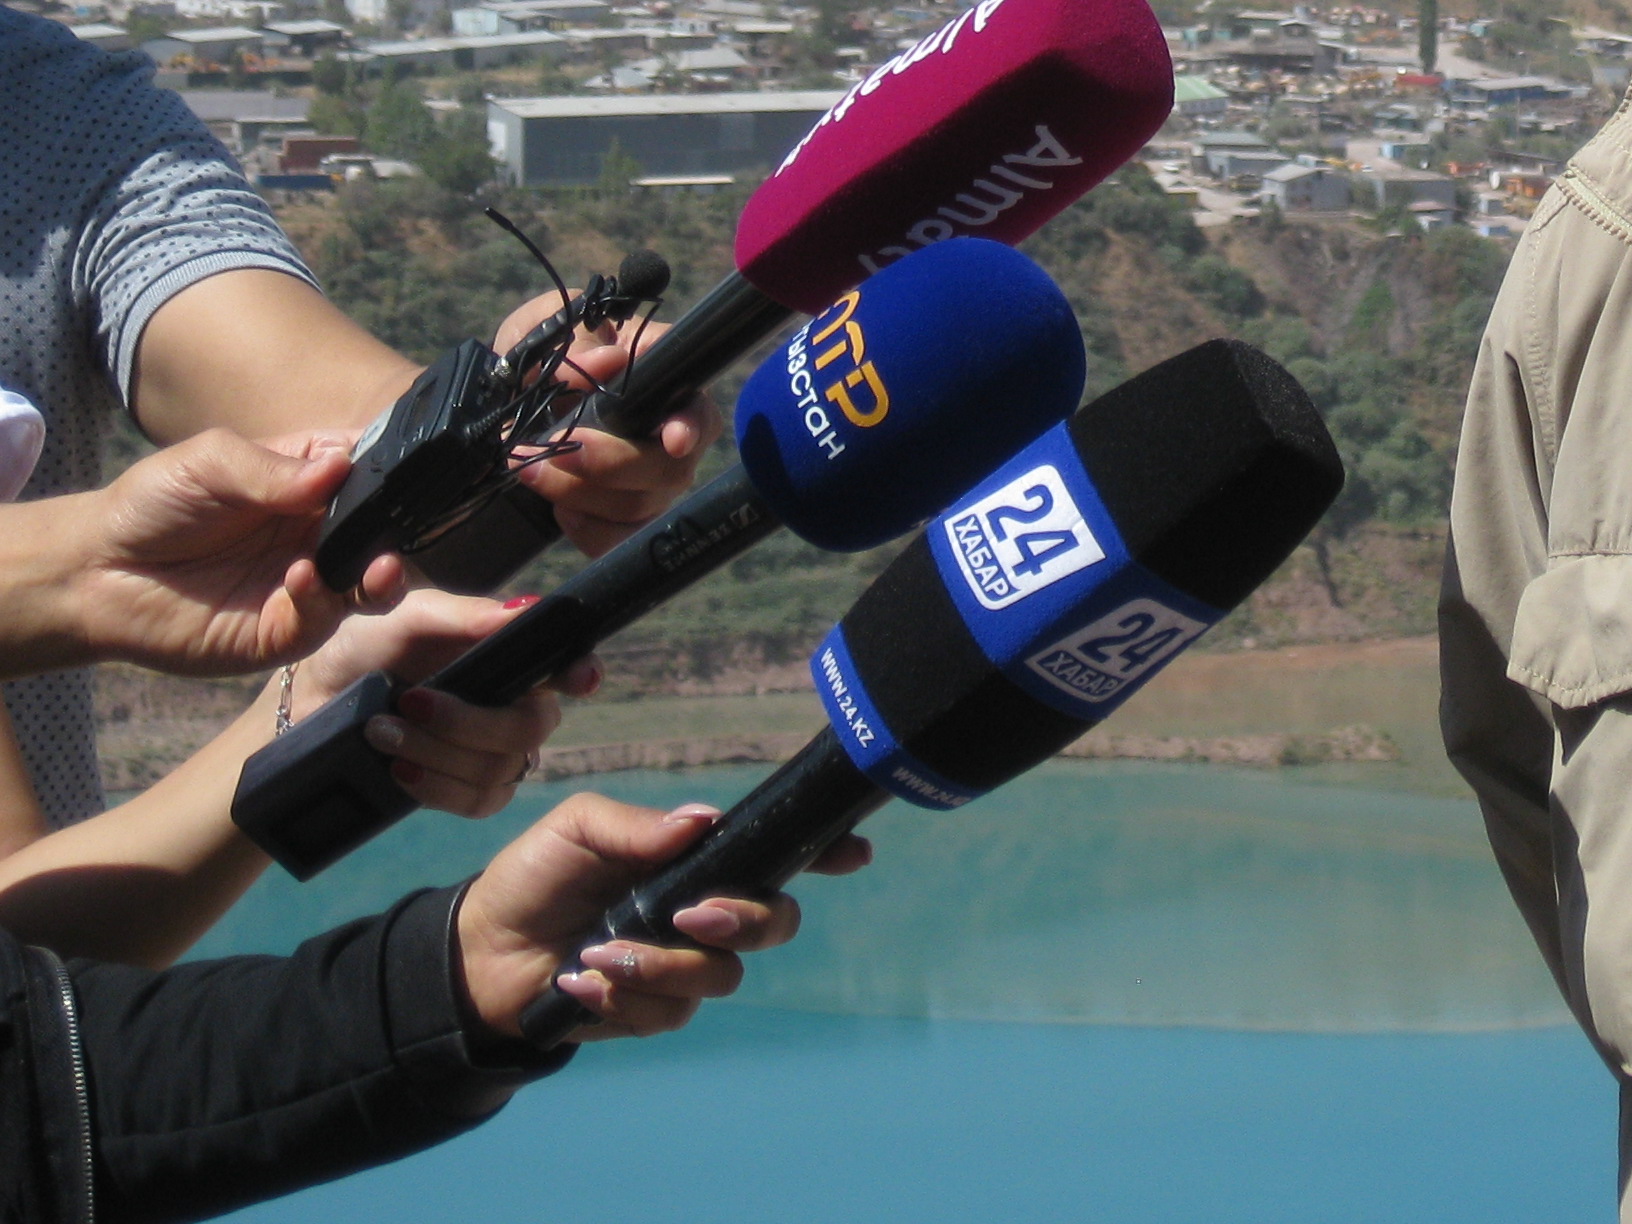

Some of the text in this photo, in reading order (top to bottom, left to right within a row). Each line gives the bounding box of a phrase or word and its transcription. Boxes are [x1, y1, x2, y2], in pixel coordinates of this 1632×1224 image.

[955, 515, 1010, 597] ХАБАР
[985, 484, 1081, 577] 24
[1043, 652, 1119, 695] ХАБАР
[1077, 611, 1185, 673] 24
[820, 646, 876, 749] WWW.24.KZ
